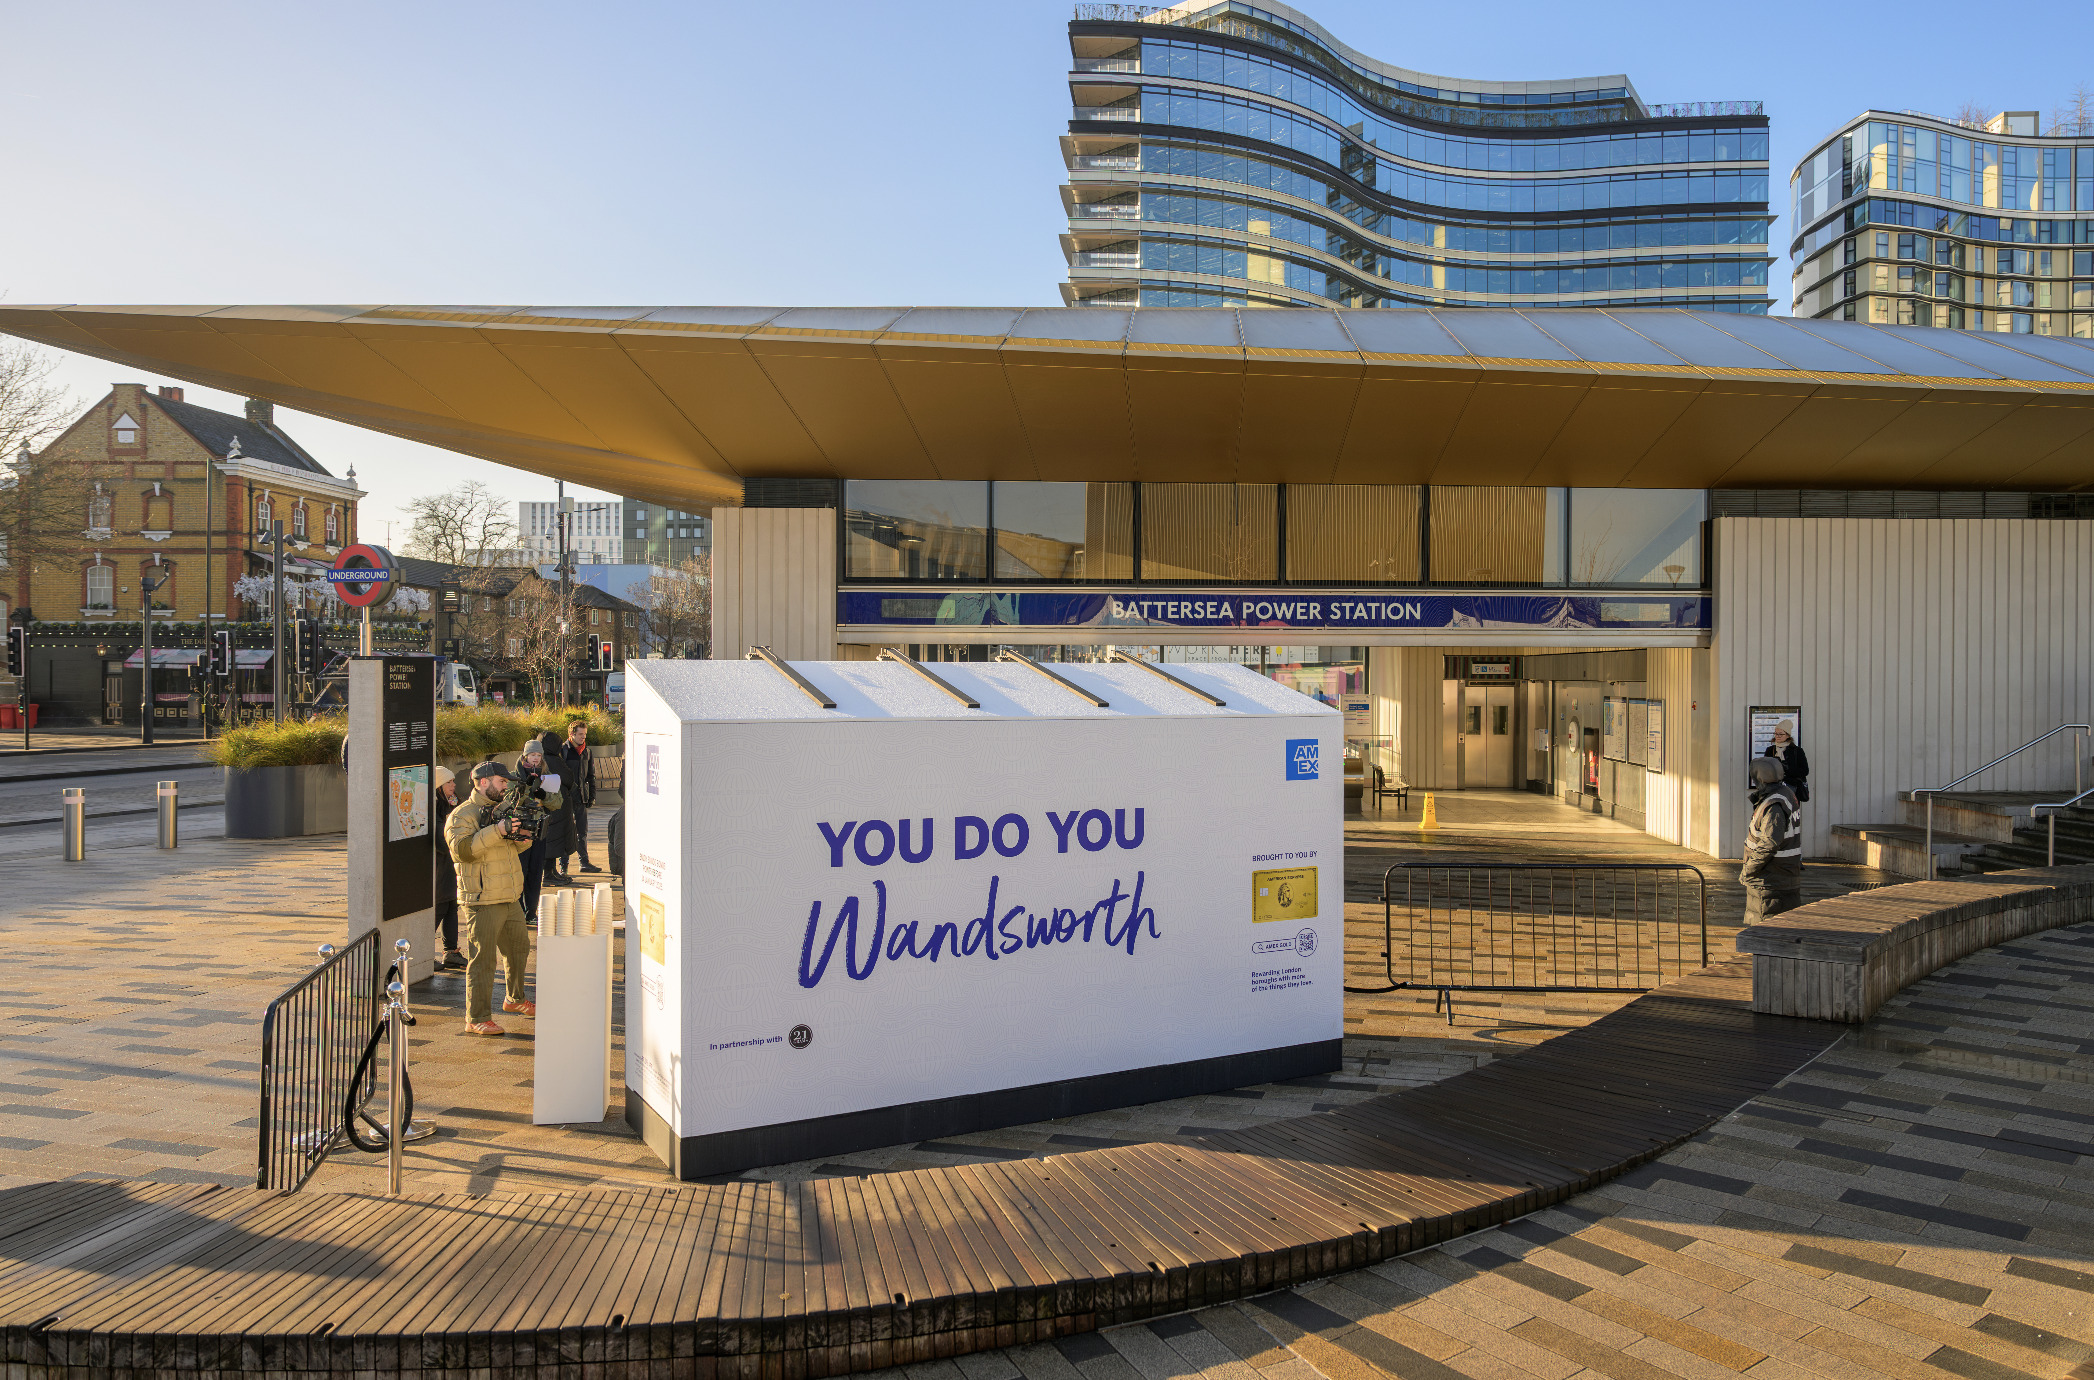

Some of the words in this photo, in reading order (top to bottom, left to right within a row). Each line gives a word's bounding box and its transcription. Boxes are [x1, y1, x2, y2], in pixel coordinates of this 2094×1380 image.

[328, 571, 388, 580] UNDERGROUND
[1112, 601, 1234, 619] BATTERSEA
[1243, 601, 1322, 619] POWER
[1330, 601, 1421, 620] STATION
[389, 673, 408, 681] POWE
[389, 681, 412, 690] STATION
[816, 818, 934, 868] YOU
[955, 813, 1030, 860] DO
[1045, 807, 1145, 853] YOU
[1252, 853, 1283, 861] BROUGHT
[1285, 852, 1294, 860] TO
[1295, 851, 1308, 859] YOU
[1309, 850, 1318, 858] BY
[798, 870, 1162, 989] Wandsworth
[793, 1030, 807, 1041] 21
[709, 1043, 718, 1051] In
[719, 1037, 765, 1051] partnership
[766, 1035, 783, 1044] with
